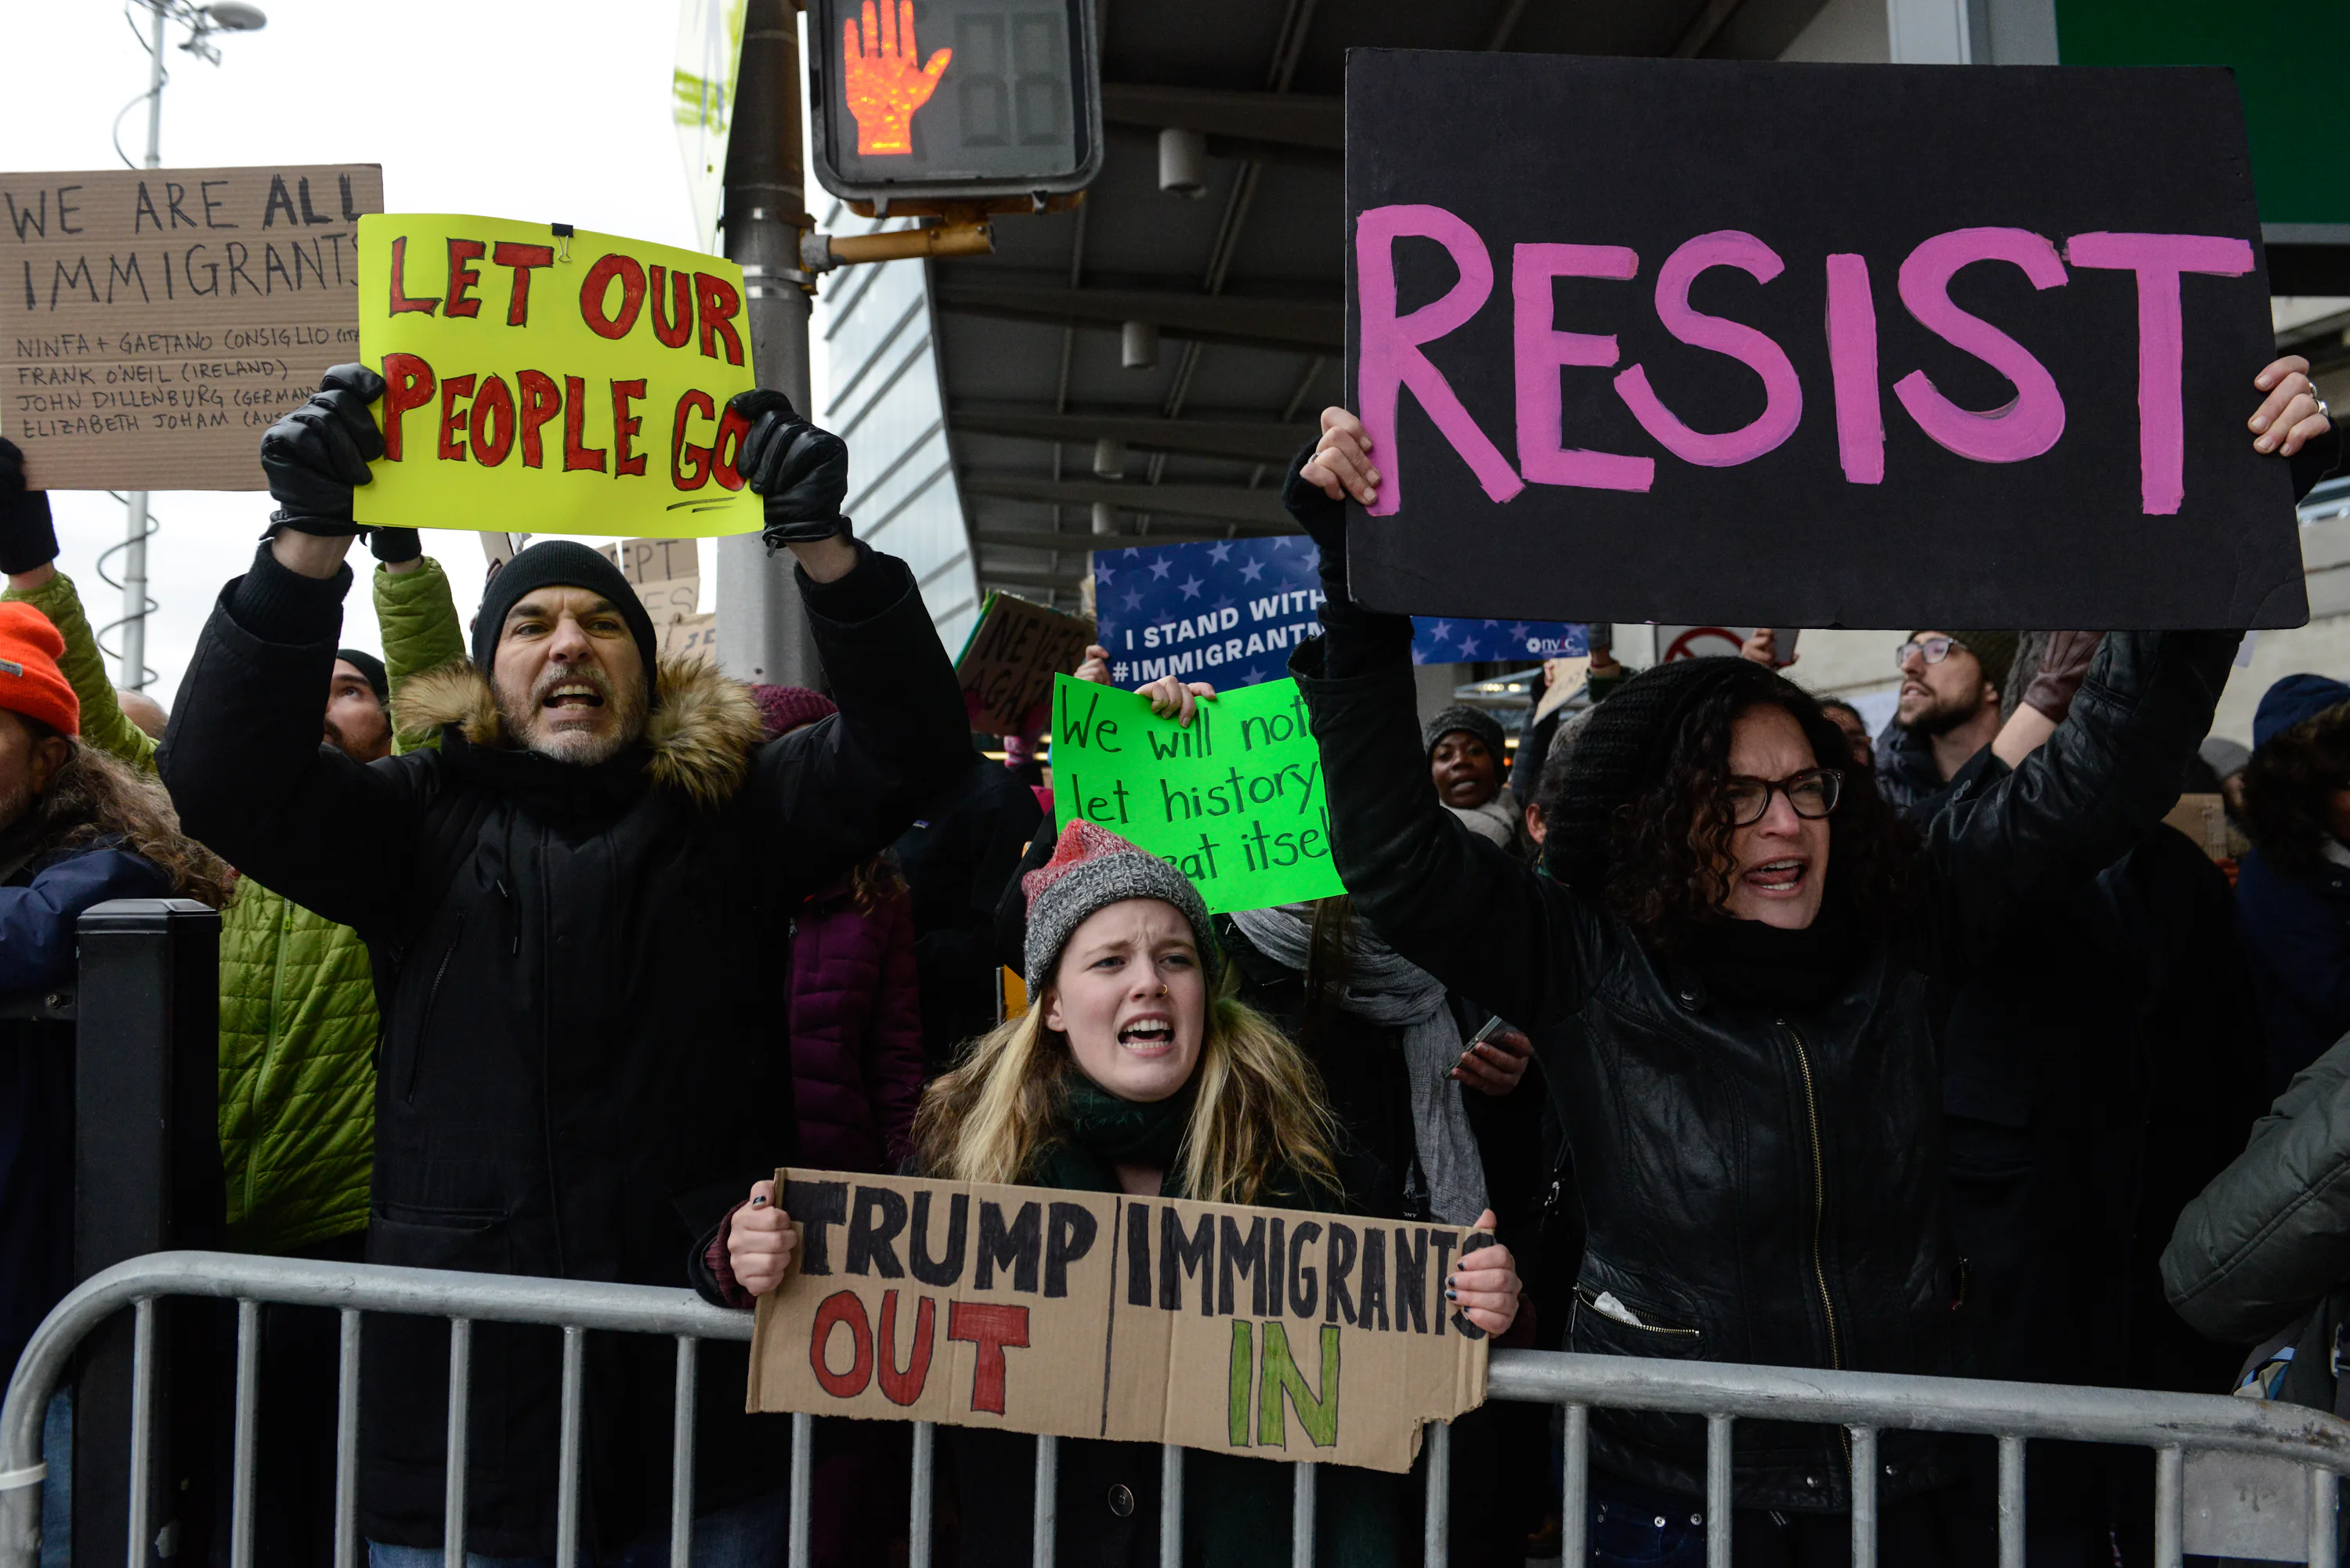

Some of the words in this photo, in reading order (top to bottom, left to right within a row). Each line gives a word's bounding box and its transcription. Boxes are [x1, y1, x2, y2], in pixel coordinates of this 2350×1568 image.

[5, 186, 83, 243] WE
[136, 180, 239, 233] ARE
[262, 172, 364, 231] ALL
[389, 236, 554, 327] LET
[580, 253, 745, 367] OUR
[16, 334, 90, 358] NINFA
[119, 331, 212, 355] GAETANO
[225, 327, 329, 349] CONSIGLIO
[19, 366, 94, 386] FRANK
[107, 364, 172, 385] O'NEIL
[182, 359, 287, 382] (IRELAND)
[1356, 204, 2255, 515] RESIST
[18, 391, 81, 412] JOHN
[94, 385, 224, 408] DILLENBURG
[24, 414, 139, 439] ELIZABETH
[155, 411, 230, 430] JOHAM
[381, 352, 647, 479] PEOPLE
[671, 388, 753, 492] GO
[980, 612, 1086, 674] NEVER
[1126, 629, 1135, 650] I
[1144, 607, 1239, 649] STAND
[1249, 589, 1327, 621] WITH
[1061, 684, 1122, 753] We
[1148, 707, 1212, 760] will
[1242, 695, 1307, 751] not
[1072, 774, 1130, 824] let
[1160, 761, 1318, 823] history
[784, 1180, 1097, 1299] TRUMP
[809, 1289, 1029, 1415] OUT
[1228, 1319, 1340, 1451] IN
